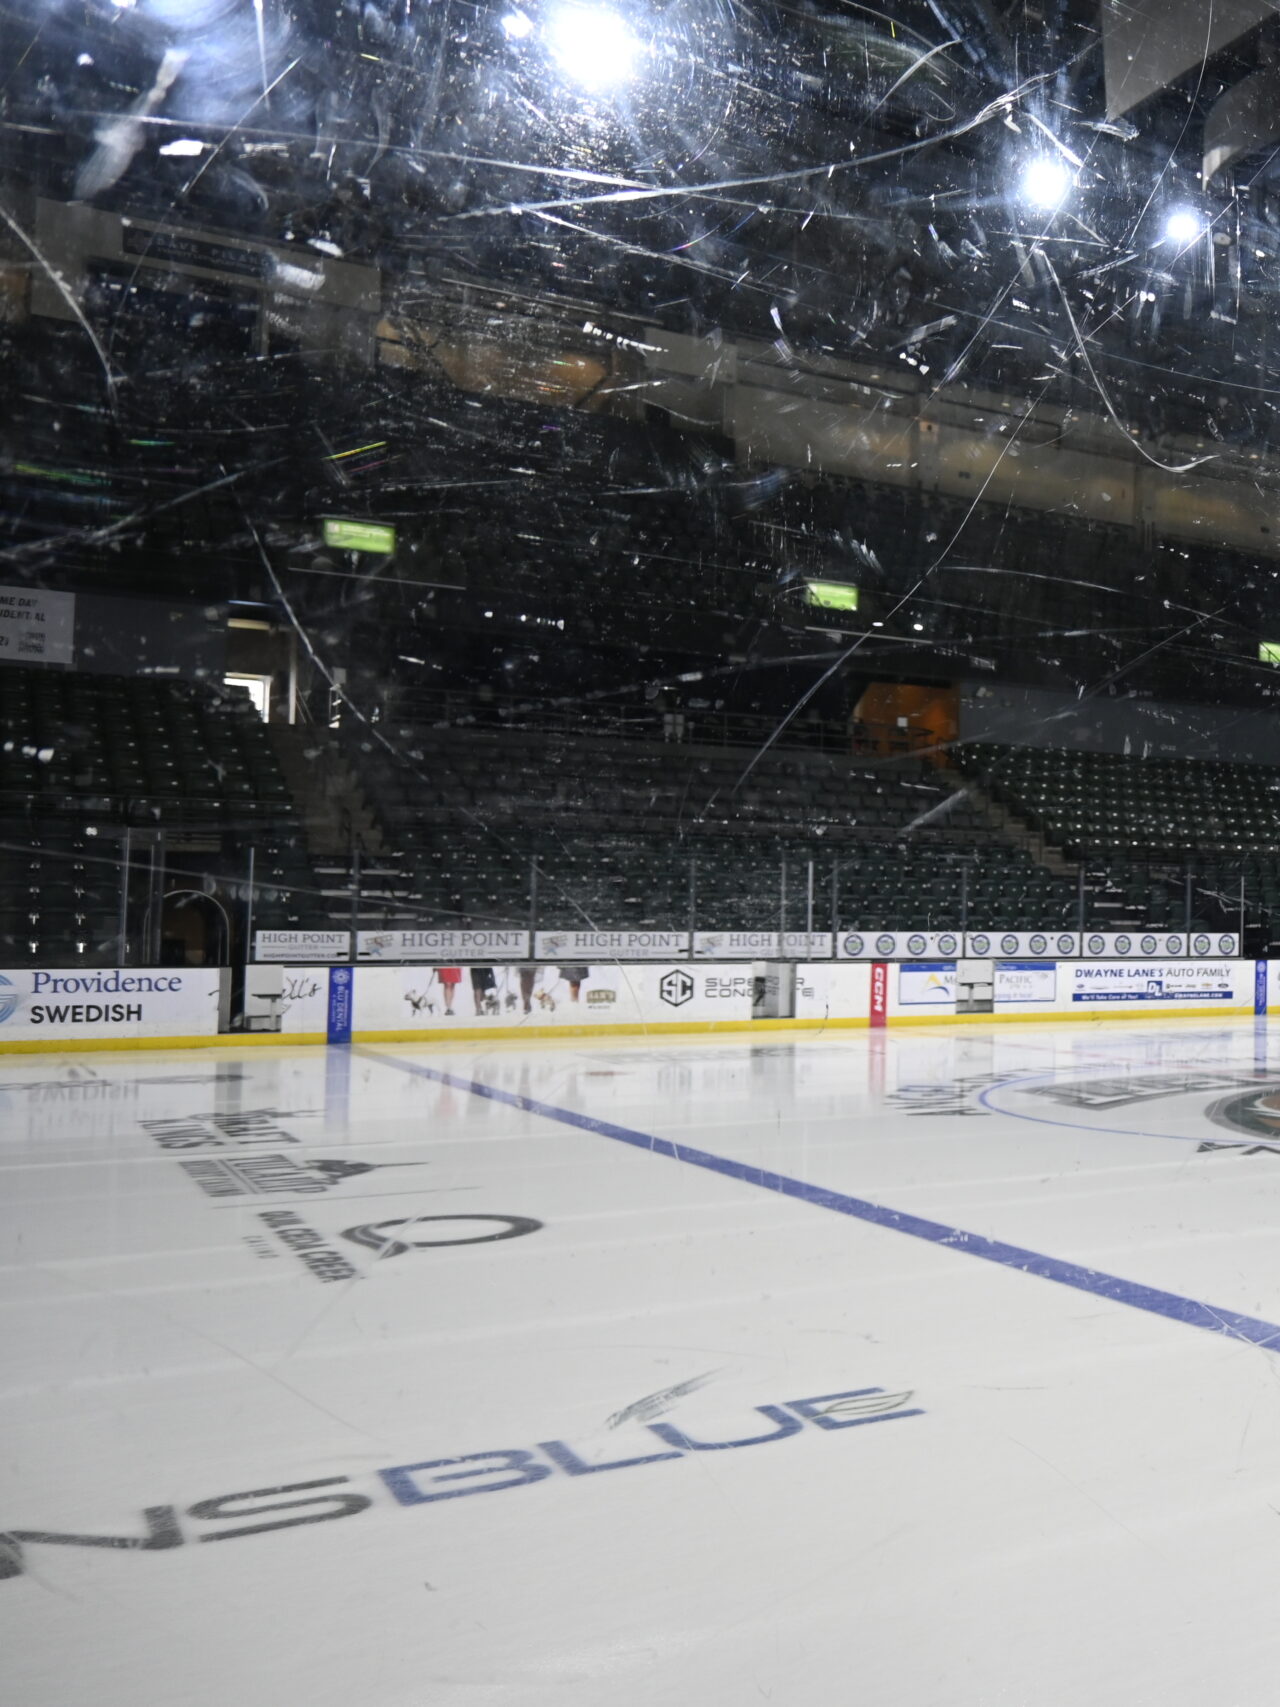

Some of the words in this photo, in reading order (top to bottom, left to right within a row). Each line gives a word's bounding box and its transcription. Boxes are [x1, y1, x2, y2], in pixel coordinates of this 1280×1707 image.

[262, 933, 298, 944] HIGH
[303, 932, 345, 944] POINT
[401, 932, 454, 947] HIGH
[461, 932, 523, 947] POINT
[574, 933, 621, 947] HIGH
[627, 933, 684, 947] POINT
[729, 934, 772, 947] HIGH
[440, 948, 485, 957] GUTTER
[1075, 969, 1124, 978] DWAYNE
[1127, 968, 1164, 978] LANE'S
[1166, 968, 1194, 977] AUTO
[1197, 967, 1231, 977] FAMILY
[31, 970, 182, 995] Providence
[873, 967, 885, 1012] CCM
[30, 1003, 142, 1024] SWEDISH
